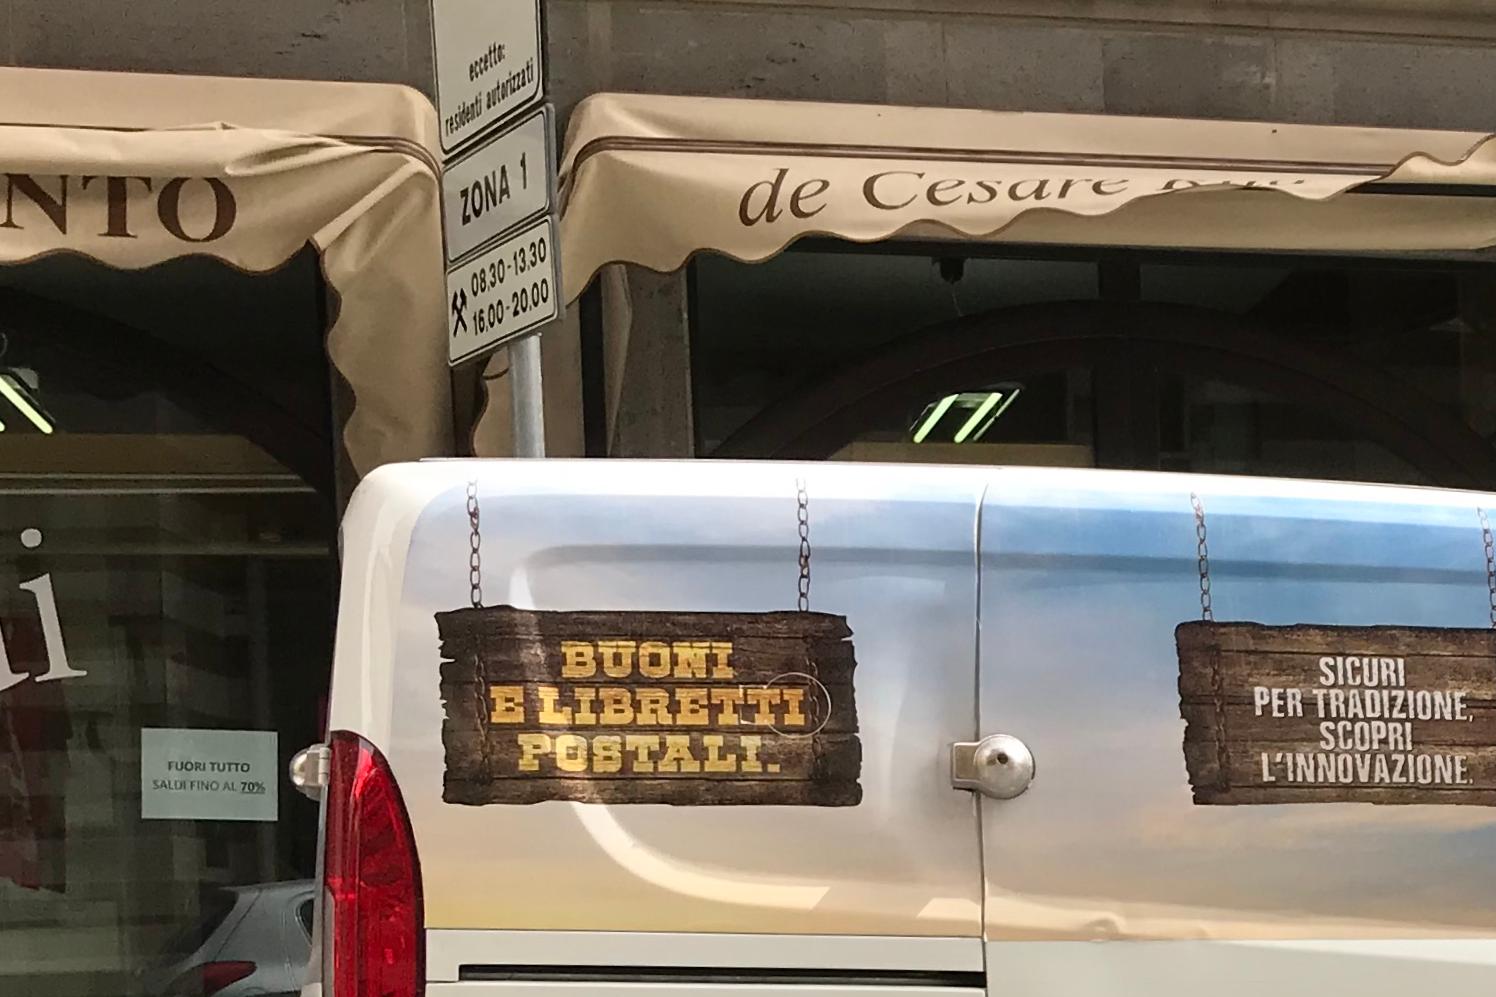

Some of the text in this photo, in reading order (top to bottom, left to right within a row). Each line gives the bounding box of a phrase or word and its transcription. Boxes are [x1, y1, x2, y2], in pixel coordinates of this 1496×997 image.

[468, 41, 505, 82] eccetto:
[445, 56, 534, 137] residenti autorizzati
[0, 172, 237, 243] NTO
[460, 151, 527, 226] ZONA 1
[738, 167, 1130, 228] de Cesare
[560, 641, 735, 679] BUONI
[1318, 656, 1406, 687] SICURI
[490, 685, 806, 726] E LIBRETTI
[1254, 686, 1475, 723] PER TRADIZIONE,
[517, 733, 781, 774] POSTALI.
[1319, 720, 1413, 752] SCOPRI
[167, 760, 251, 773] FUORI TUTTO
[1261, 752, 1474, 785] L'INNOVAZIONE.
[152, 779, 266, 794] SALDI FINO AL 70%
